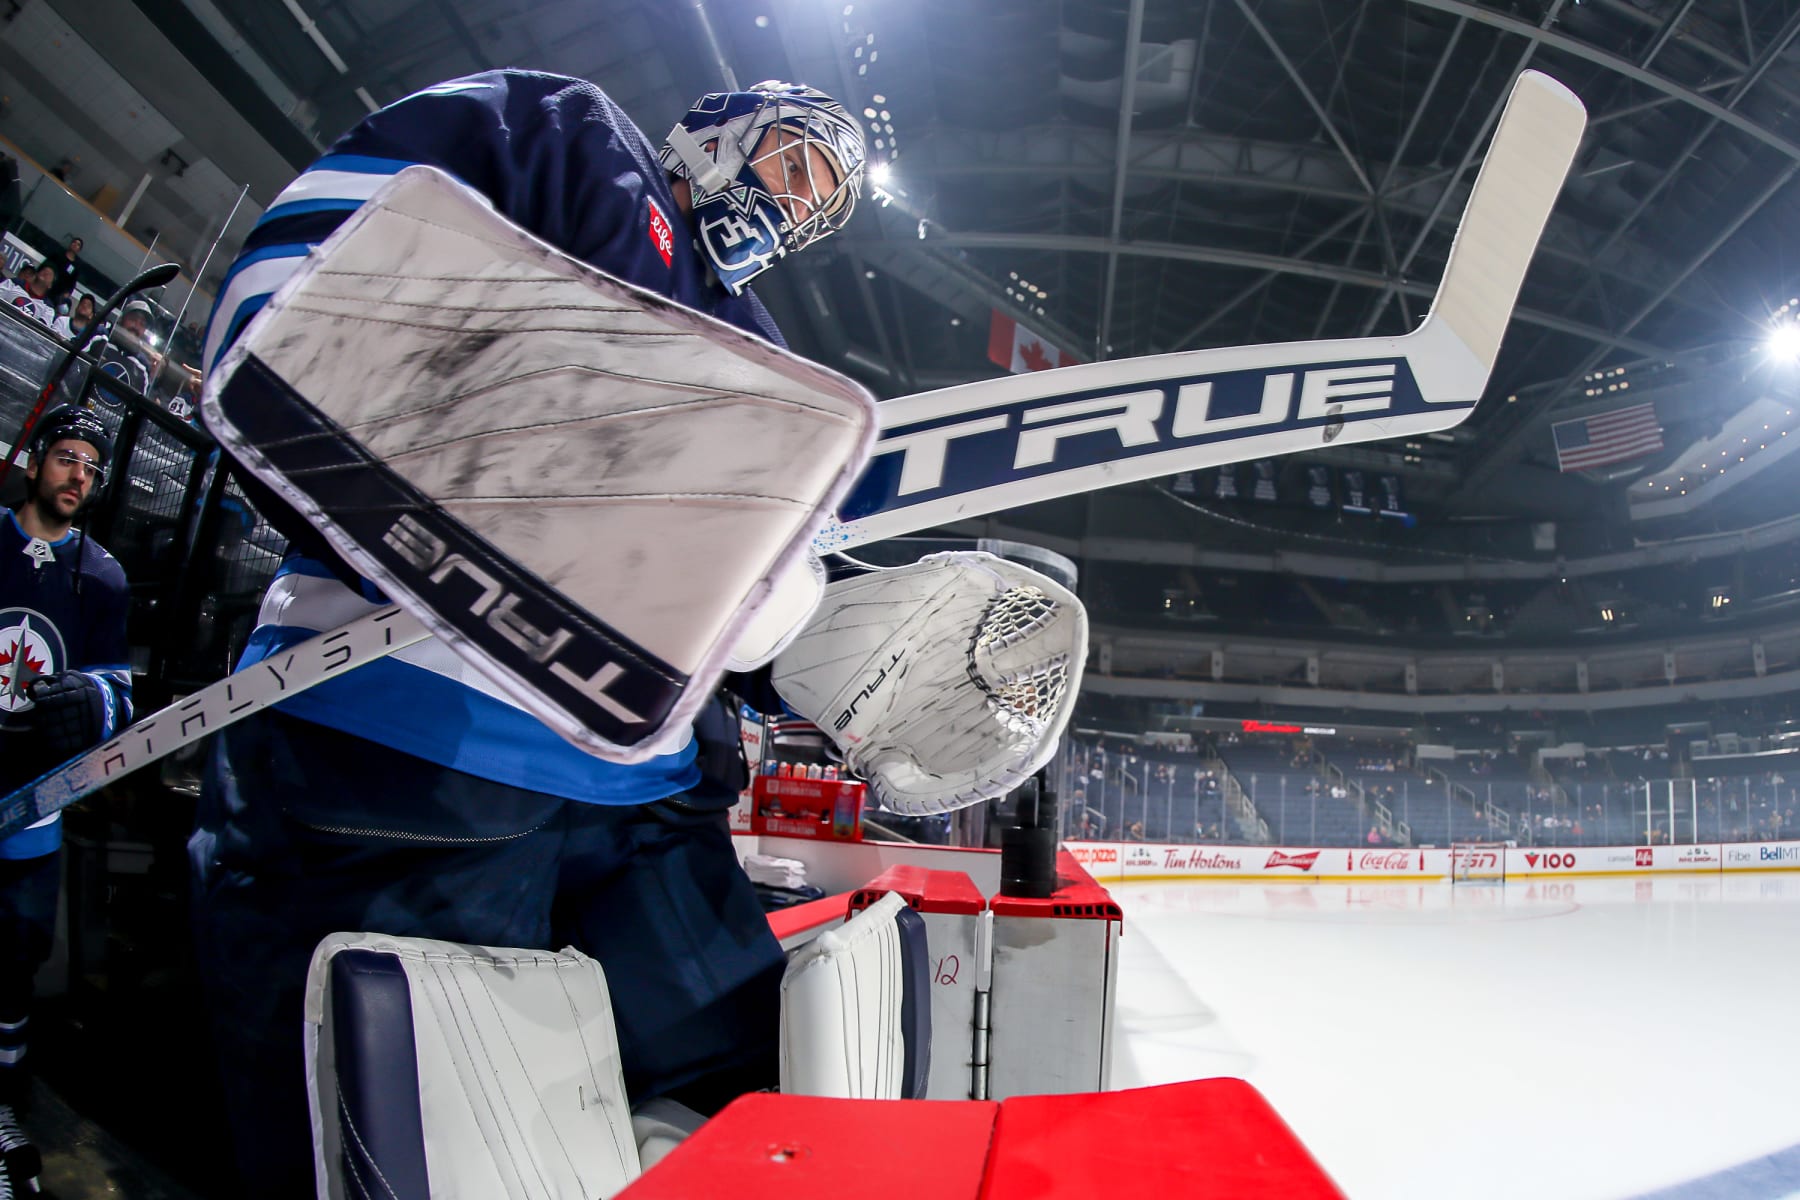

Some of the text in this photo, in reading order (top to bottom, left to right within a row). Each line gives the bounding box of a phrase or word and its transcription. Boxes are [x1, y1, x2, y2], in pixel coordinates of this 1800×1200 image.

[875, 364, 1396, 496] TRUE
[382, 514, 648, 723] TRUE
[63, 608, 402, 792] CATALYST
[834, 648, 906, 732] TRUE
[1164, 849, 1242, 869] Tim Hortons
[1448, 852, 1498, 868] TSN
[1543, 853, 1576, 869] 100
[935, 955, 960, 985] 12
